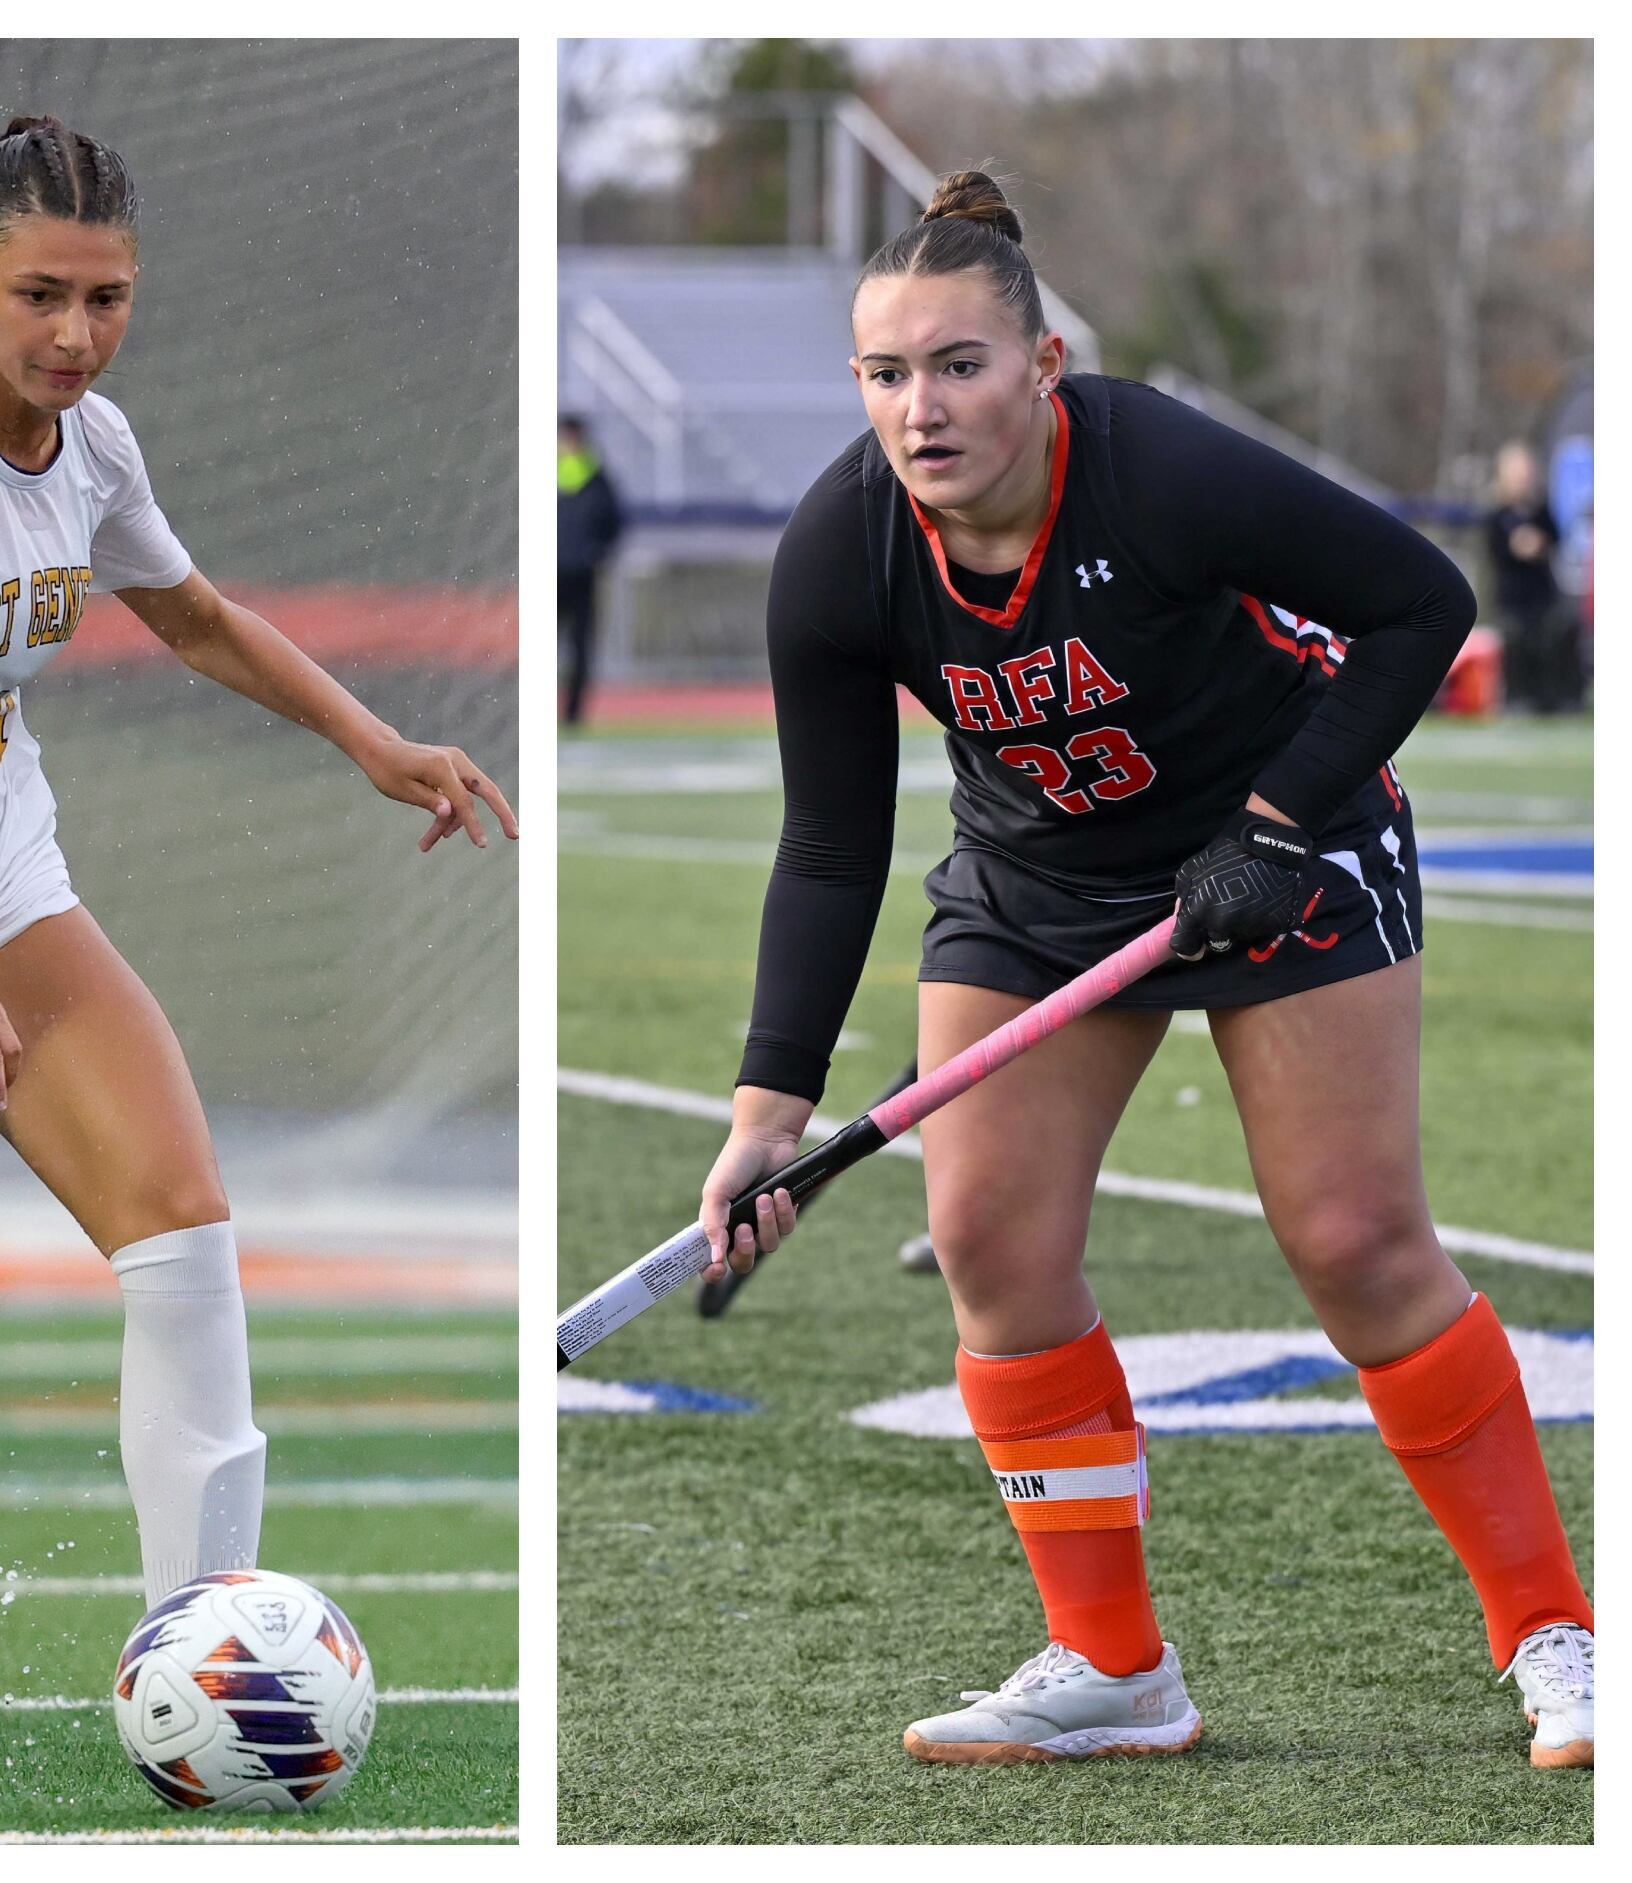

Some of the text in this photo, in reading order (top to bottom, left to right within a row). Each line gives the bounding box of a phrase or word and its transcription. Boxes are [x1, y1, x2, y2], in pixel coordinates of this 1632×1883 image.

[941, 637, 1130, 731] RFA
[995, 726, 1157, 815] 23
[1253, 833, 1307, 855] GRYPHON
[993, 1474, 1046, 1499] TAIN
